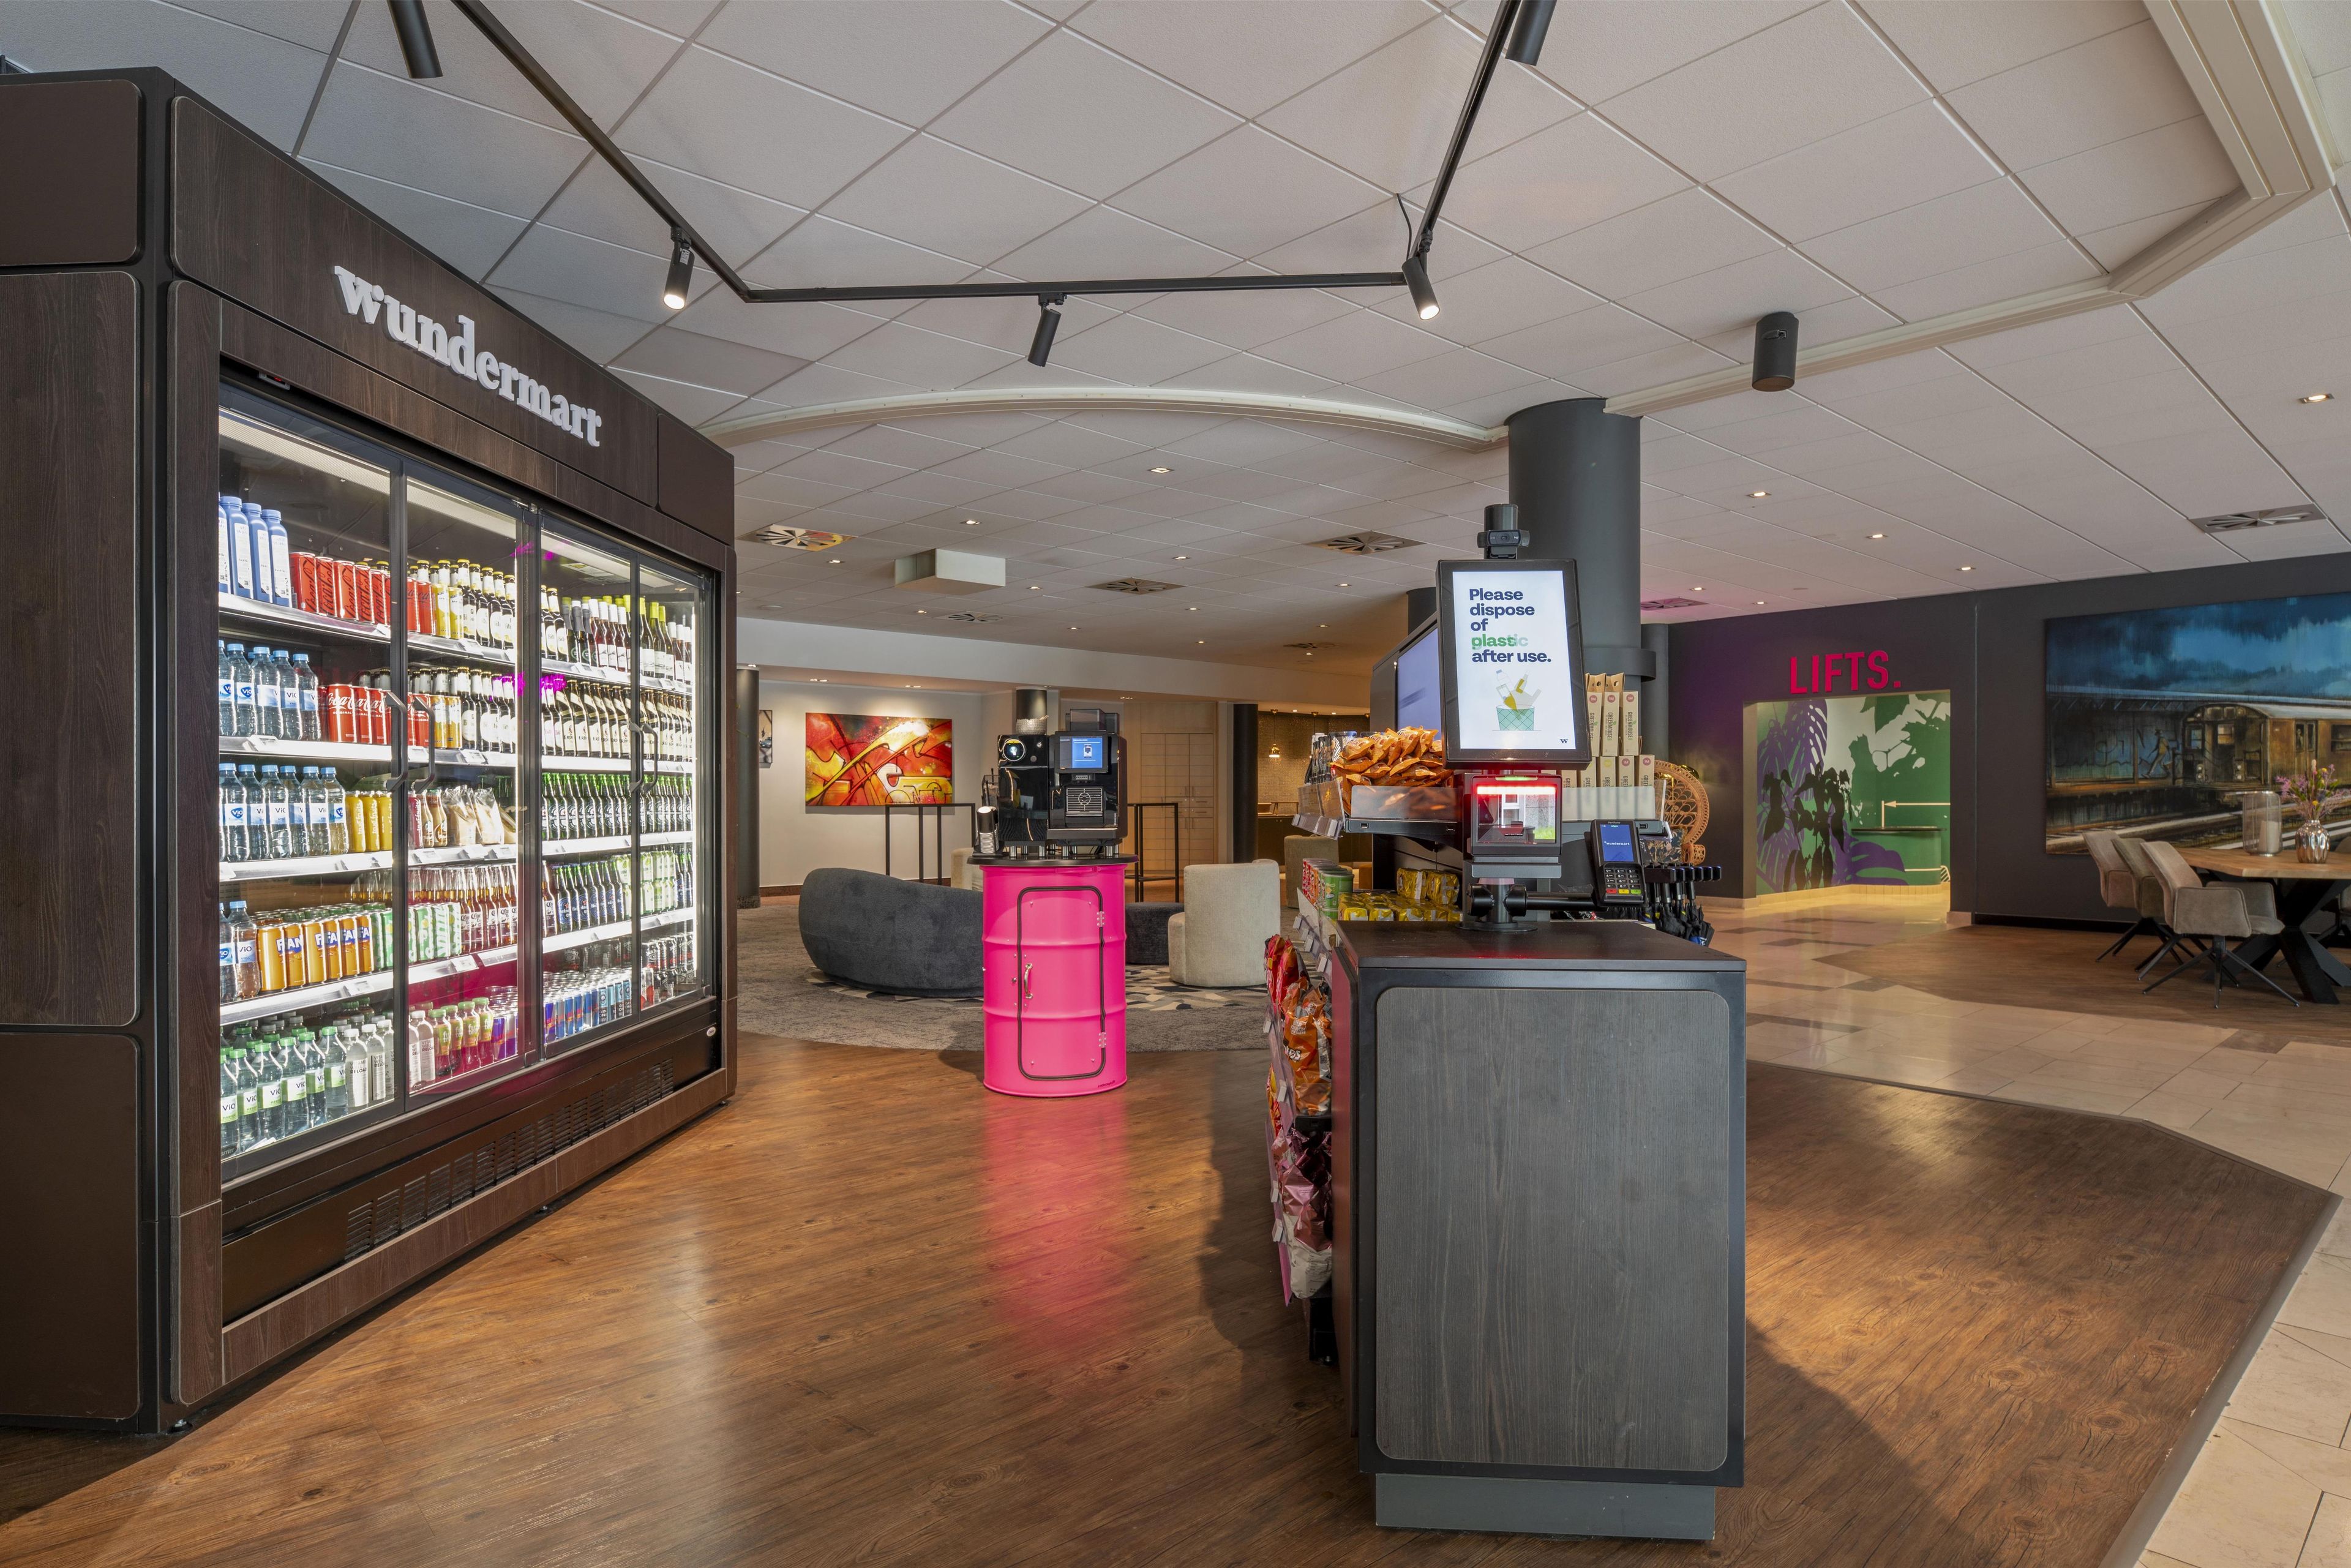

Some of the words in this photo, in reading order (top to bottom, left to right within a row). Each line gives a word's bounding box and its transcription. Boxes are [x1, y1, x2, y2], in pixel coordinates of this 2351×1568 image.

[334, 266, 602, 447] wundermart
[1469, 588, 1524, 601] Please
[1469, 603, 1535, 619] dispose
[1470, 618, 1488, 631] of
[1472, 649, 1514, 662] after
[1517, 652, 1552, 662] use.
[1790, 650, 1901, 694] LIFTS.
